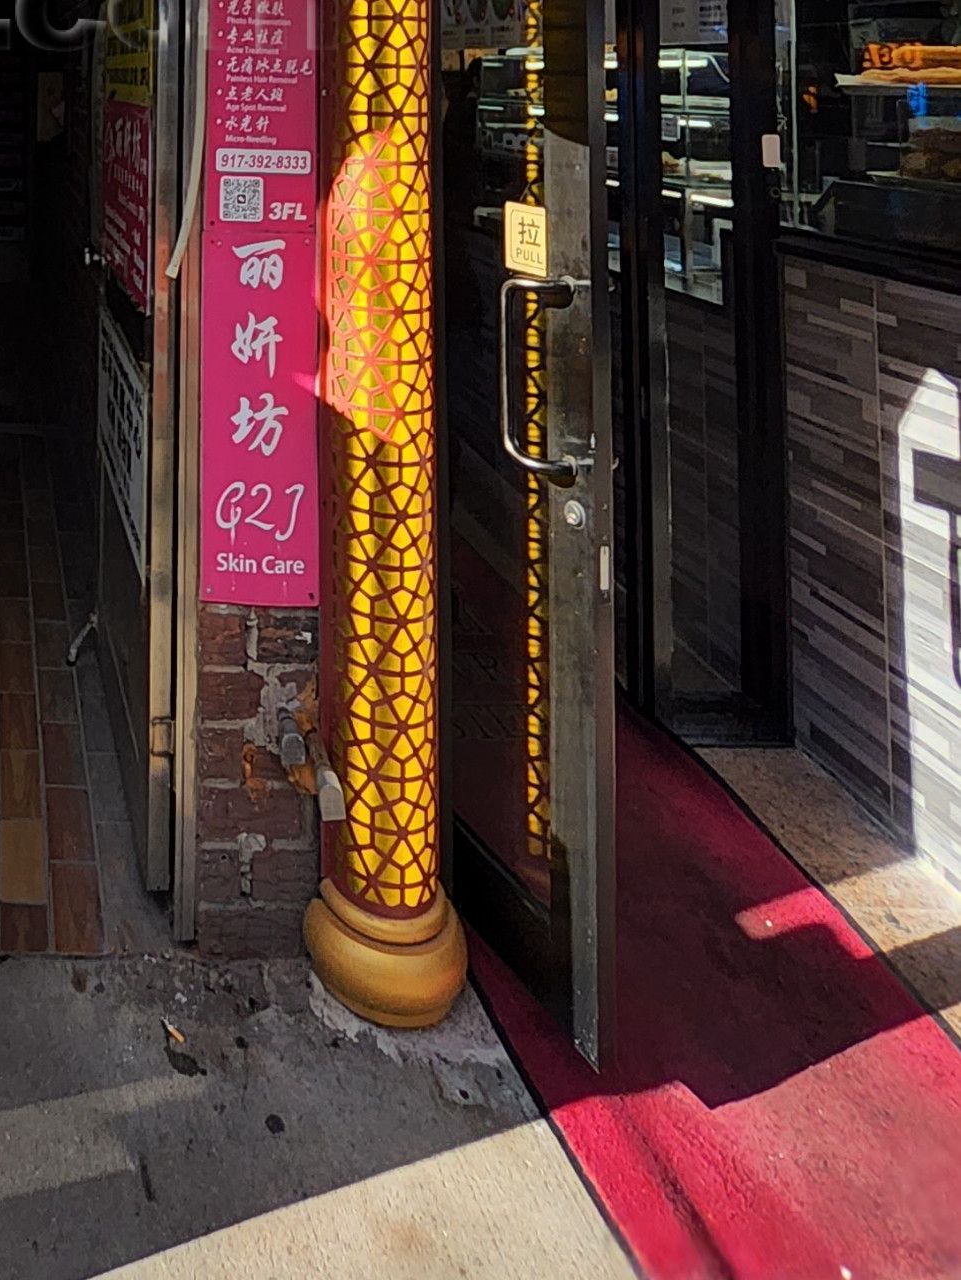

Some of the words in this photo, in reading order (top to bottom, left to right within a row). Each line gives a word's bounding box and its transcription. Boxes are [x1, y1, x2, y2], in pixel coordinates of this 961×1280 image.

[221, 154, 307, 170] 917-392-8333
[269, 202, 307, 221] 3FL
[518, 216, 541, 246] 拉
[516, 247, 543, 265] PULL
[231, 239, 289, 458] 丽妍坊
[216, 552, 257, 574] Skin
[261, 555, 305, 575] Care
